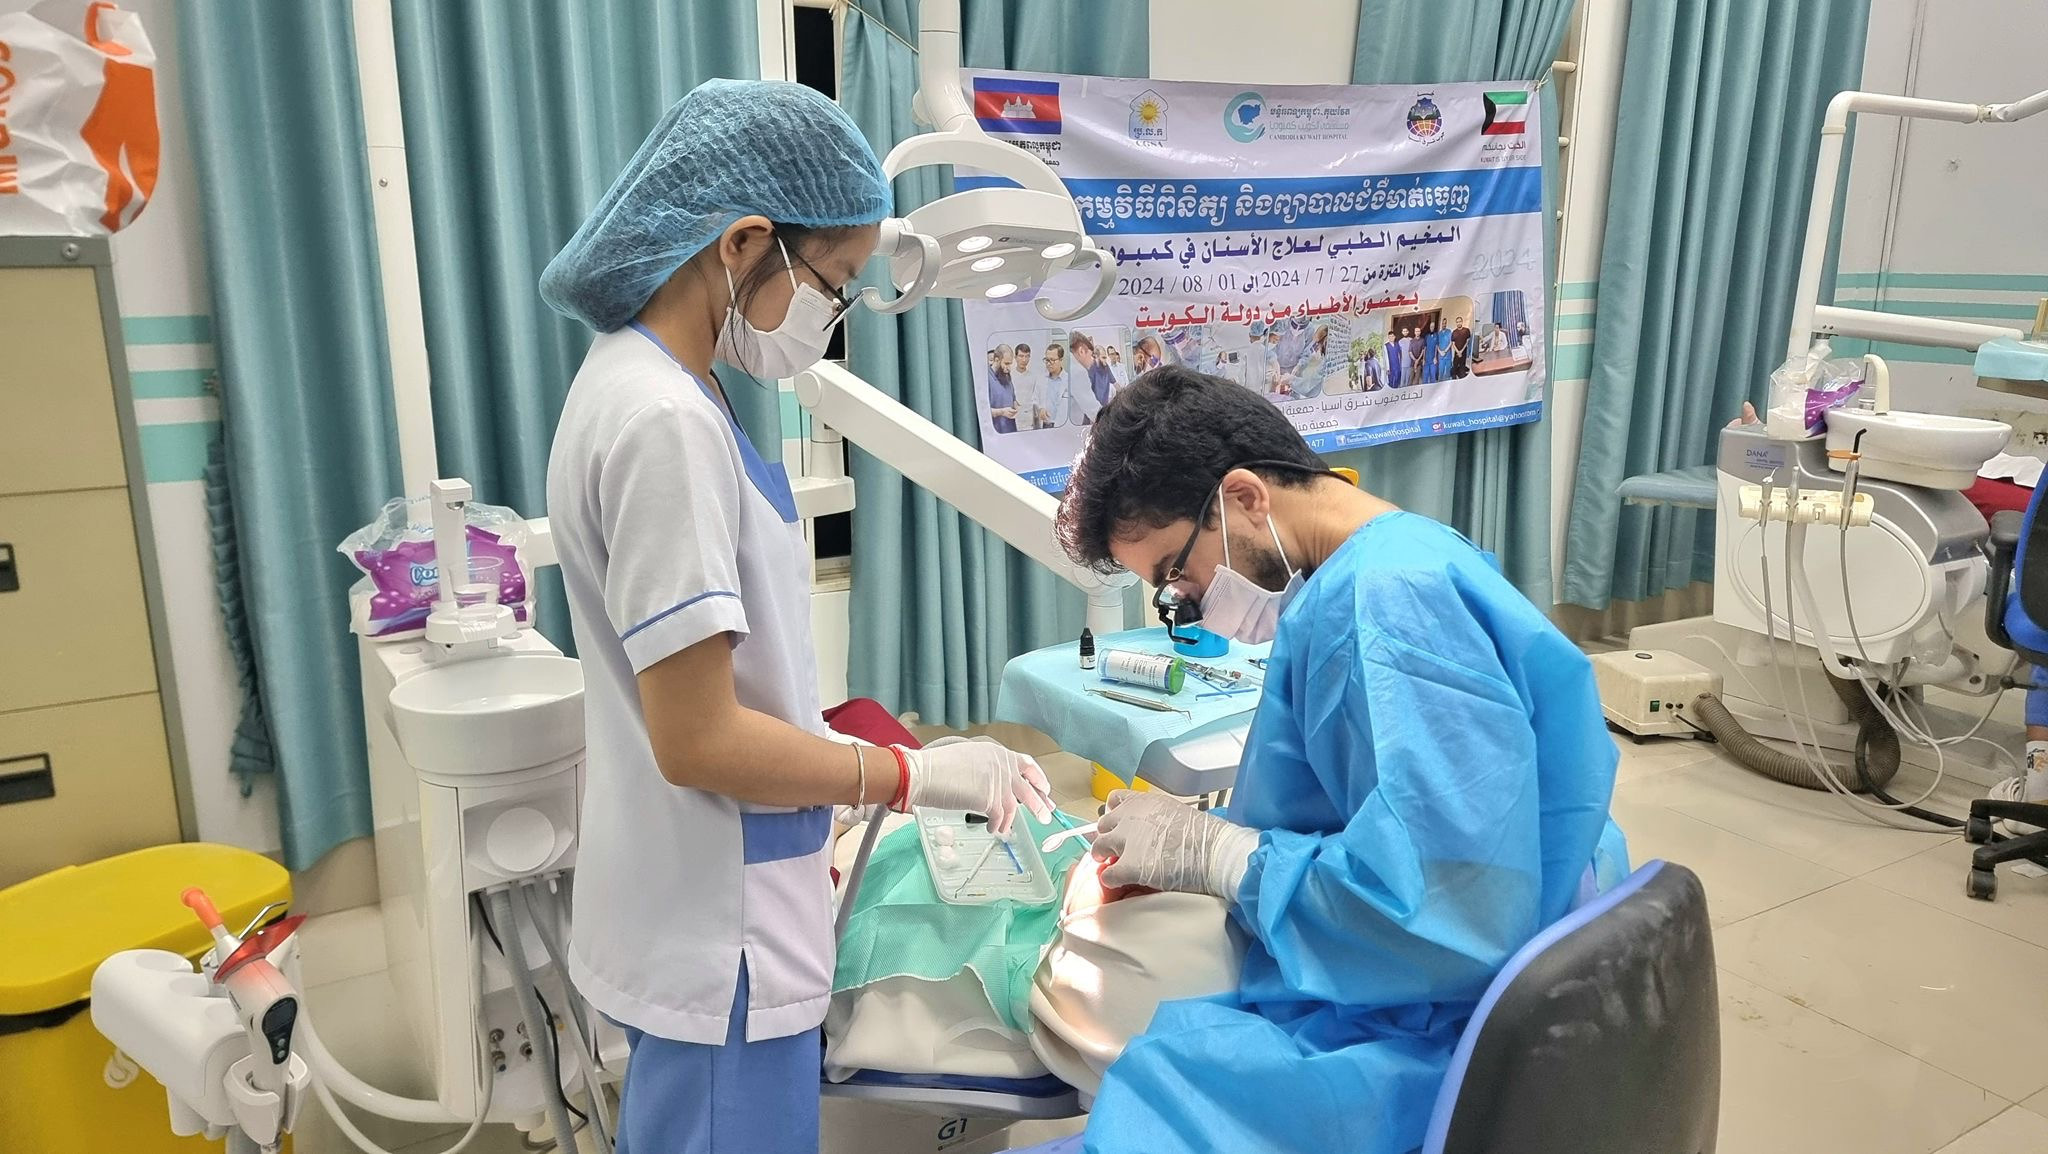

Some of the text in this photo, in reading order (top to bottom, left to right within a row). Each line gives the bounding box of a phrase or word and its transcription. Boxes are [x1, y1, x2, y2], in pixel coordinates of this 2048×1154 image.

[1328, 229, 1391, 259] الطبي
[1396, 224, 1461, 251] المخيم
[1179, 237, 1196, 269] في
[1201, 232, 1268, 264] الأسنان
[1272, 234, 1324, 261] لعلاج
[1262, 269, 1300, 288] 2024
[1315, 268, 1324, 284] 7
[1340, 265, 1359, 283] 27
[1362, 268, 1377, 285] من
[1378, 262, 1406, 281] الفترة
[1407, 259, 1431, 280] خلال
[1118, 277, 1165, 296] 2024
[1182, 273, 1203, 293] 08
[1218, 273, 1236, 291] 01
[1242, 274, 1259, 294] إلى
[1135, 288, 1420, 333] بحضور الأطباء من دولة الكويت
[1344, 396, 1372, 412] شرق
[1374, 395, 1399, 407] جنوب
[1401, 389, 1423, 402] لجنة
[1286, 405, 1315, 417] جمعية
[1309, 419, 1339, 431] جمعية
